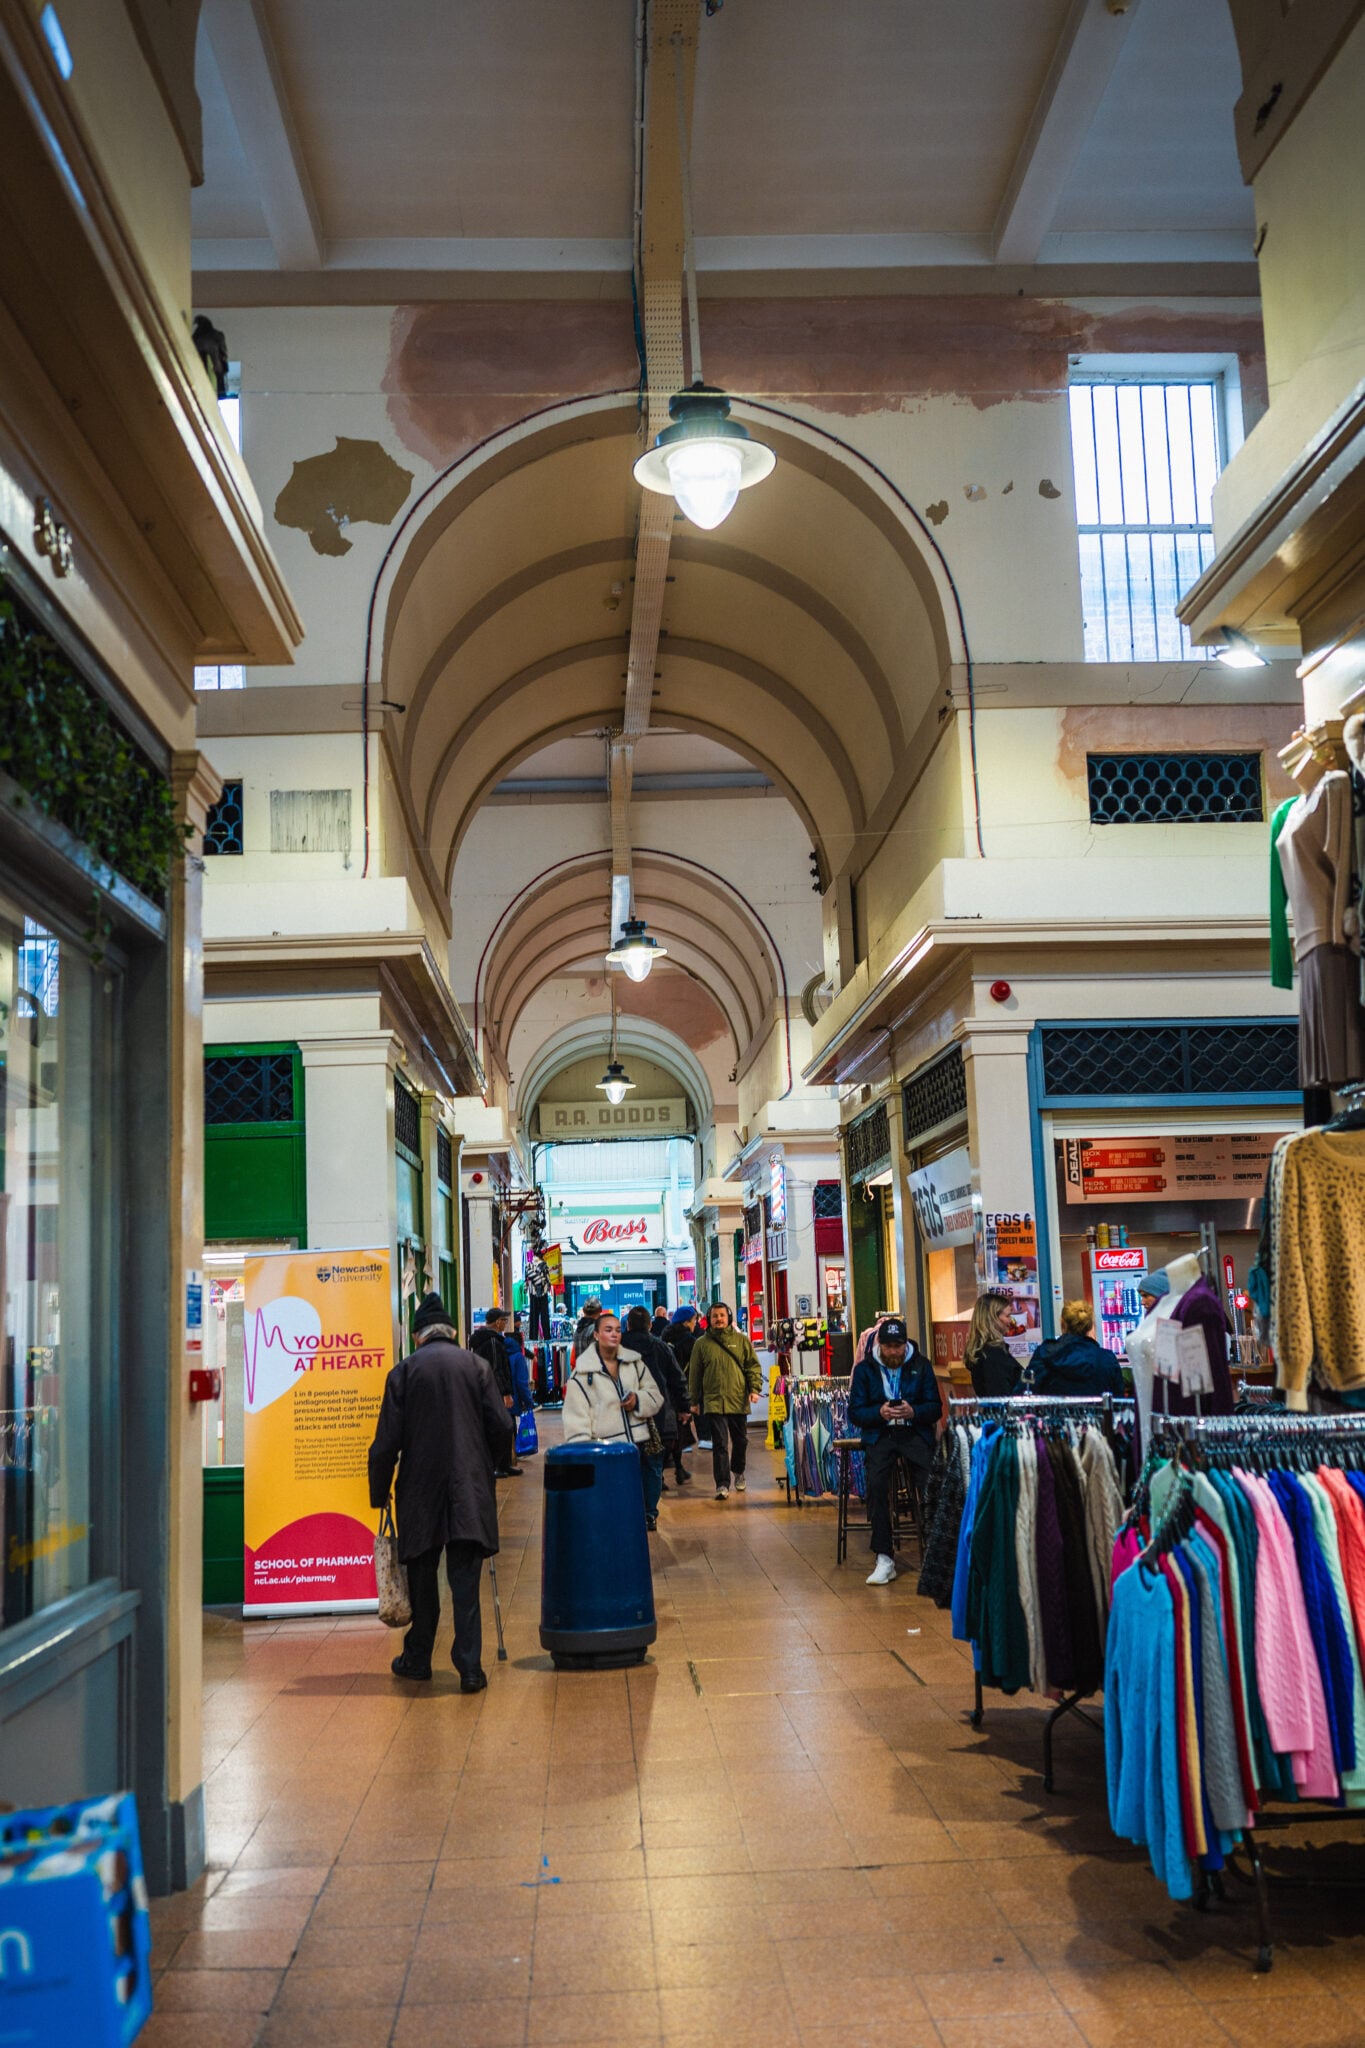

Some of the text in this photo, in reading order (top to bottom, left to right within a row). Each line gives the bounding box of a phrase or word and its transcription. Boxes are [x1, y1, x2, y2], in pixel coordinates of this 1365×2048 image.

[555, 1106, 671, 1126] R.A. DODDS
[583, 1217, 648, 1245] Bass
[332, 1263, 382, 1274] Newcastle
[332, 1273, 382, 1283] University
[294, 1333, 364, 1350] YOUNG
[294, 1353, 385, 1371] AT HEART
[314, 1390, 340, 1398] people
[294, 1398, 341, 1406] undiagnosed
[343, 1396, 358, 1404] high
[294, 1407, 326, 1415] pressure
[304, 1414, 340, 1422] increased
[294, 1423, 321, 1431] attacks
[322, 1422, 337, 1430] and
[254, 1555, 374, 1570] SCHOOL OF PHARMACY
[254, 1574, 337, 1586] ncl.ac.uk/pharmacy
